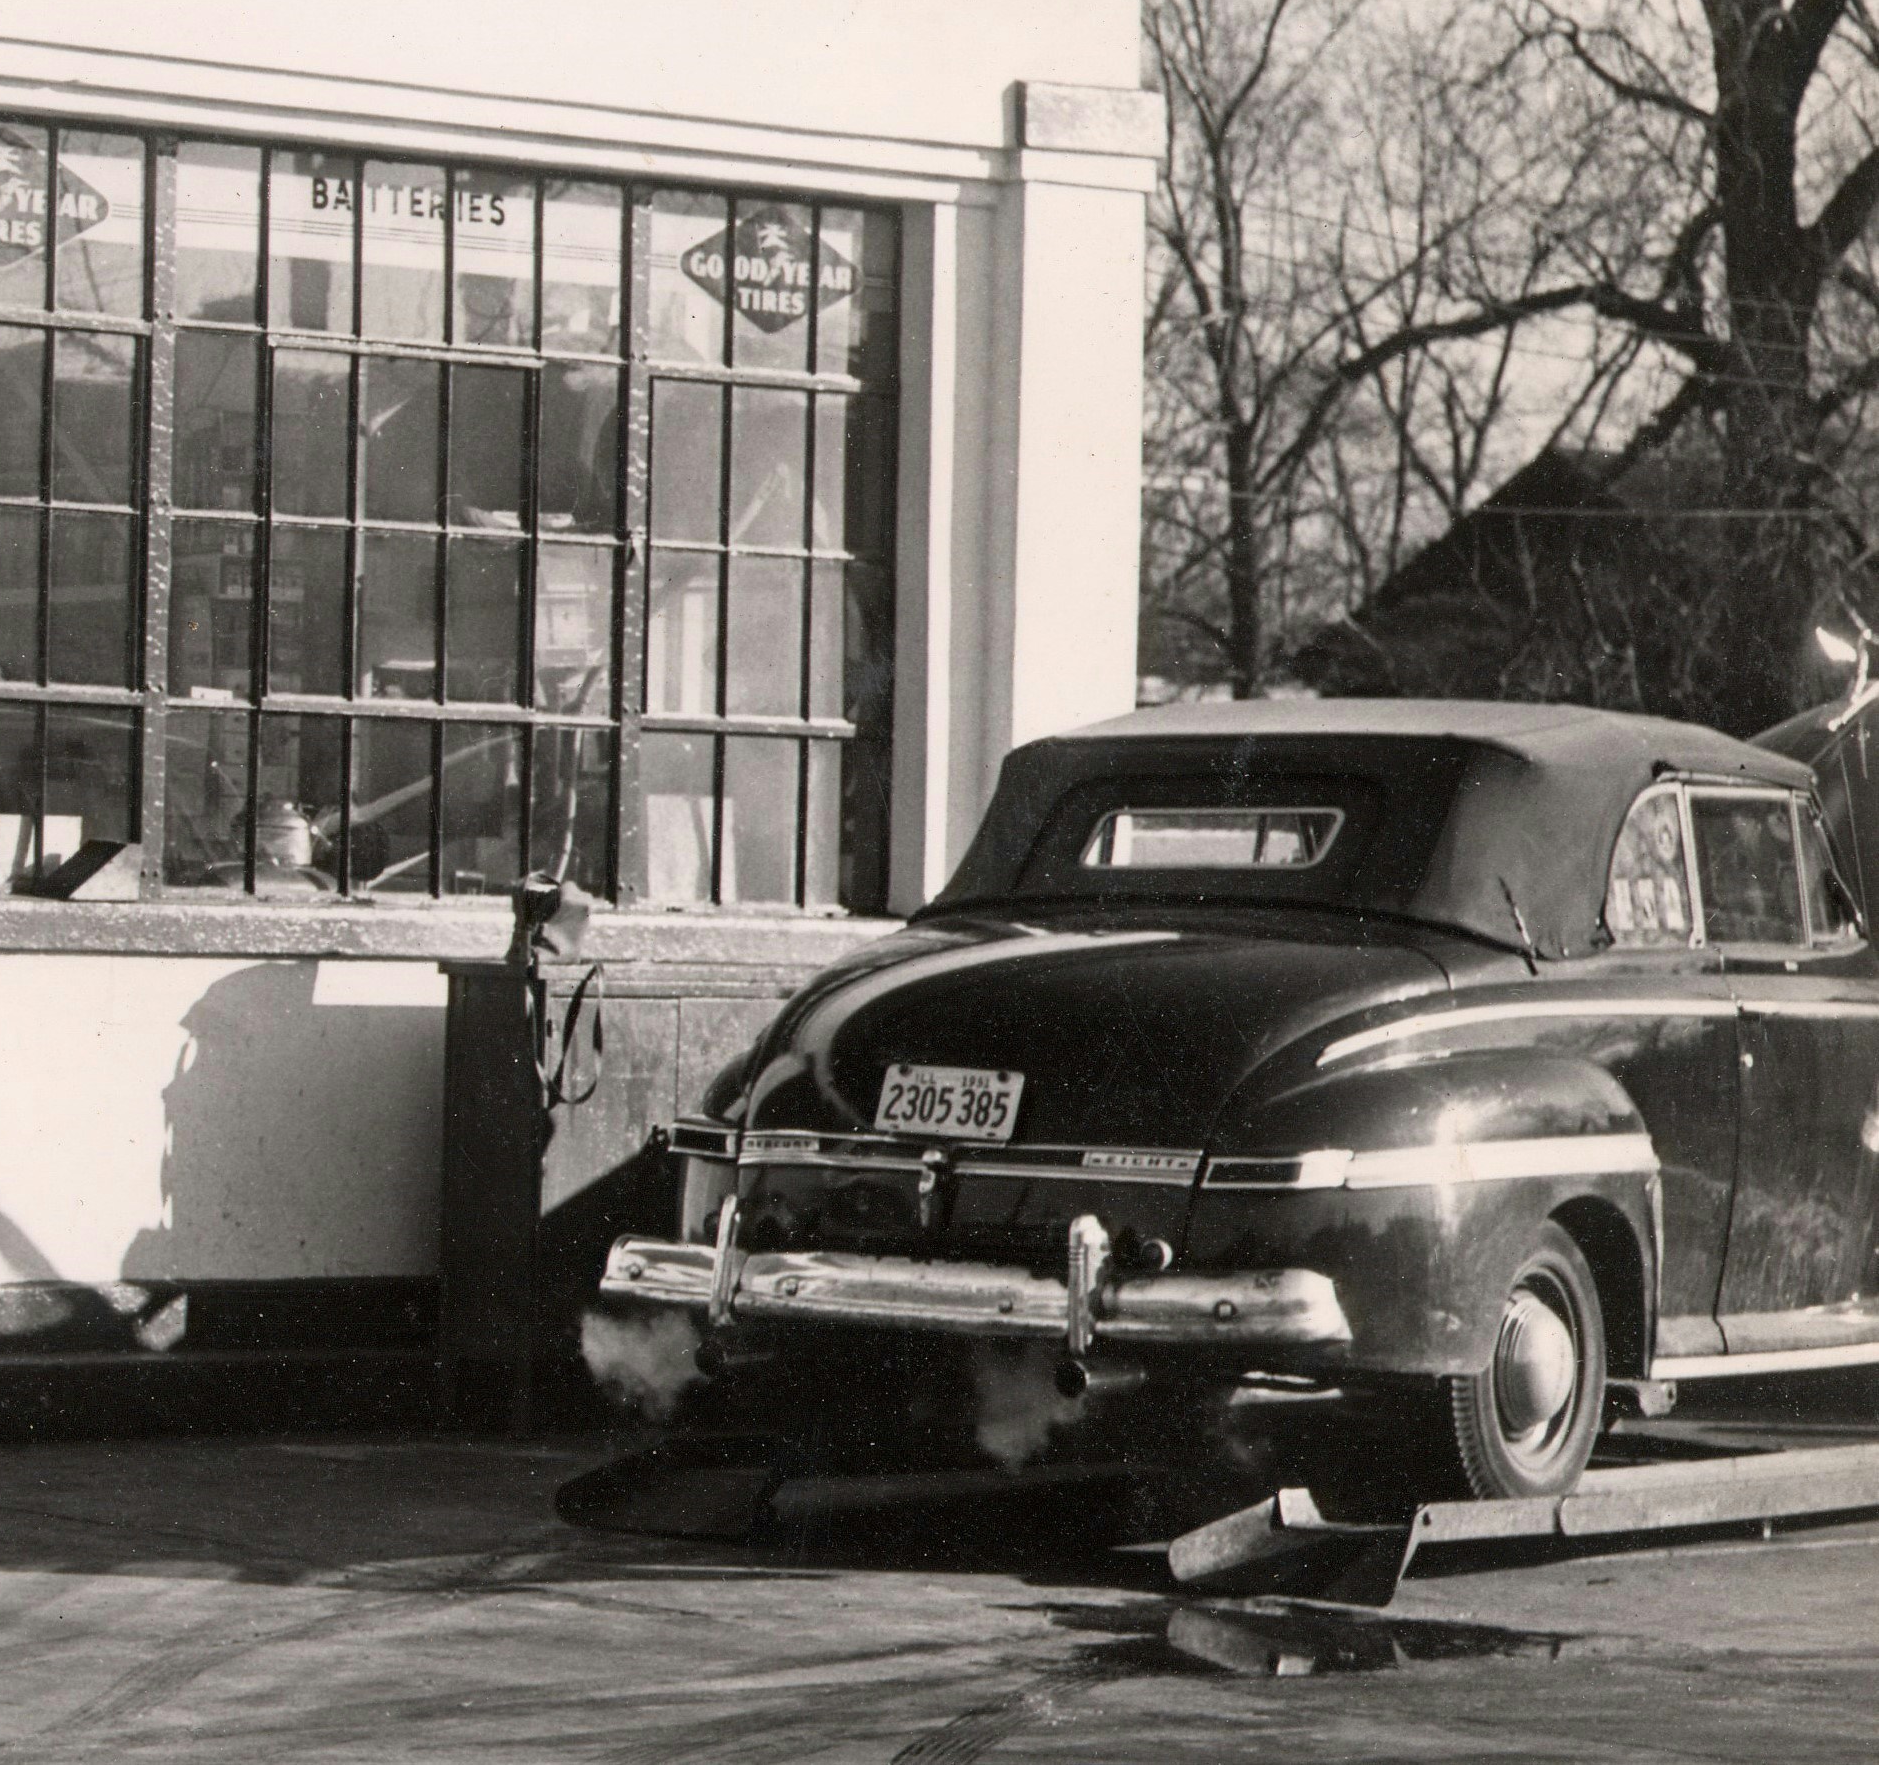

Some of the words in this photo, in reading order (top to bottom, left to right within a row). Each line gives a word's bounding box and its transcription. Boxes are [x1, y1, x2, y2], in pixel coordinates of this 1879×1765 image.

[311, 176, 506, 226] BATTERIES
[690, 250, 853, 291] GOODYEAR
[737, 287, 806, 316] TIRES
[915, 1072, 937, 1085] ILL
[883, 1083, 954, 1124] 2305
[956, 1089, 1010, 1128] 385
